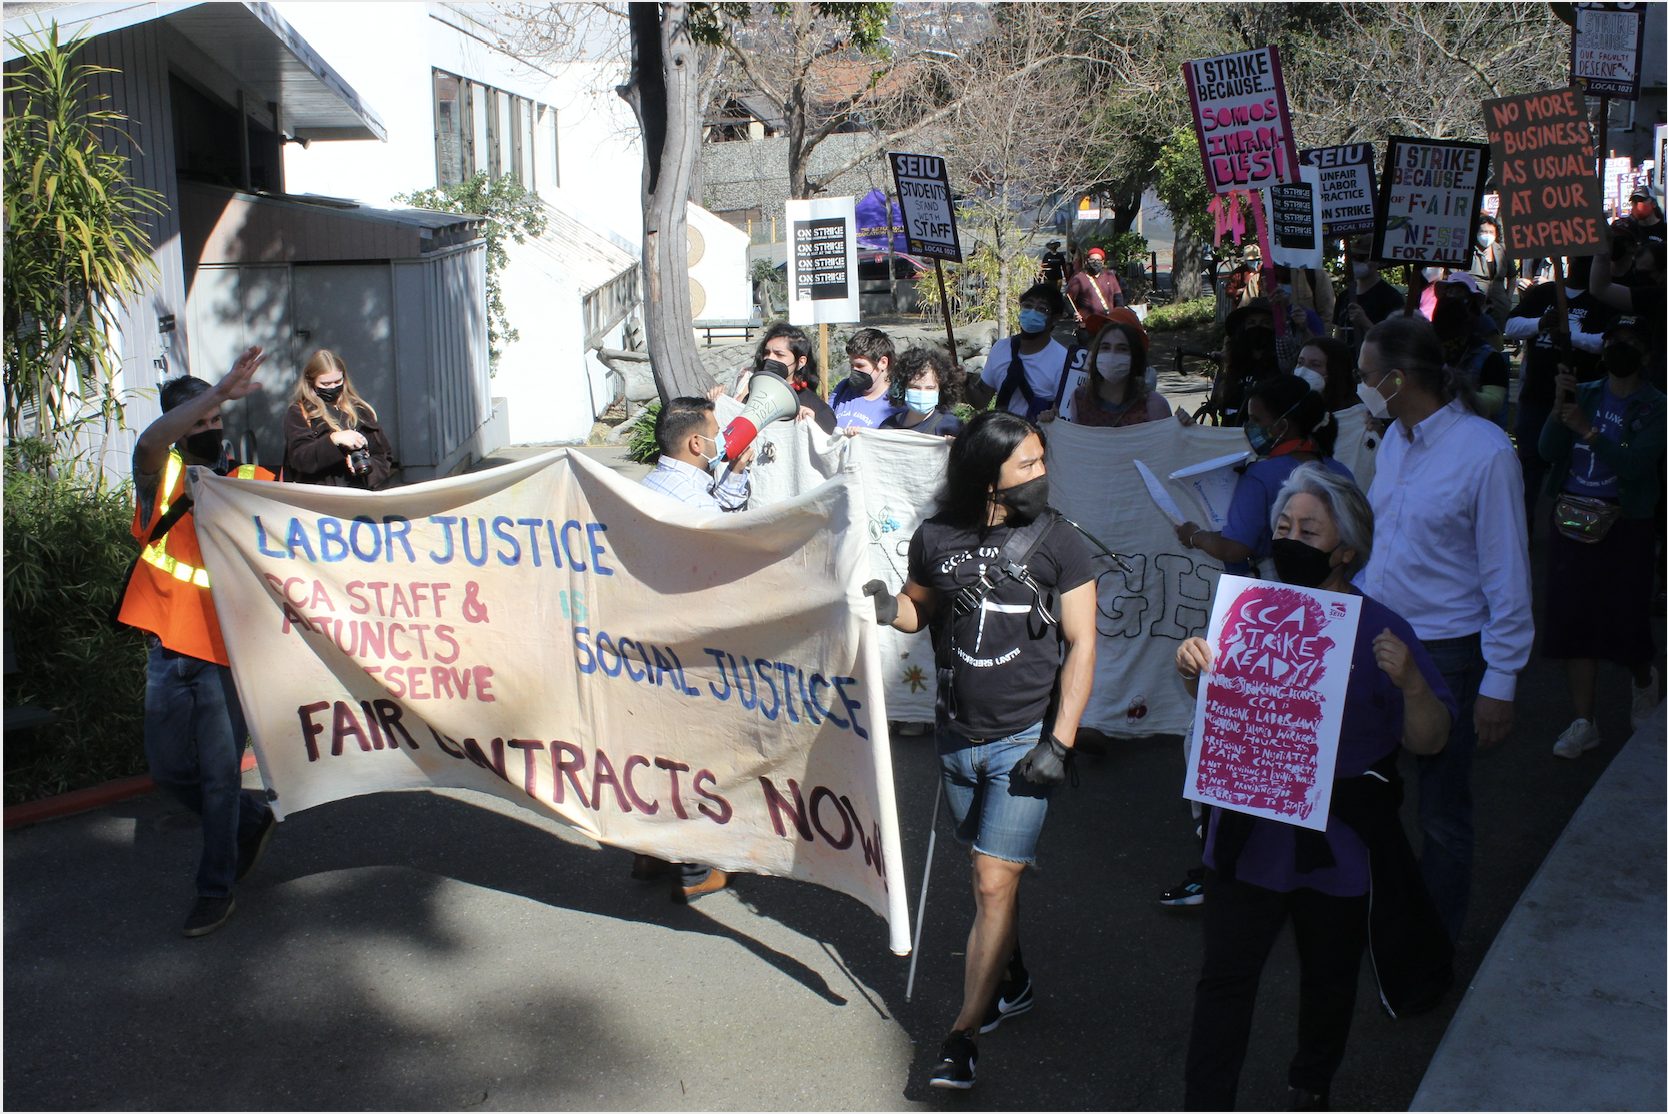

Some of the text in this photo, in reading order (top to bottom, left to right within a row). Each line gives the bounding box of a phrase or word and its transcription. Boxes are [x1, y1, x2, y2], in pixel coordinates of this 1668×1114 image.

[1585, 12, 1636, 35] STRIKE
[1581, 51, 1629, 62] OUR FACULTY
[1194, 52, 1268, 84] I STRIKE
[1580, 61, 1617, 77] DESERVE
[1591, 83, 1616, 91] LOCAL
[1618, 85, 1632, 93] 1021
[1202, 98, 1278, 131] SOMOS
[1492, 92, 1578, 129] NO MORE
[897, 155, 939, 178] SEIU
[1308, 145, 1364, 168] SEIU
[1395, 145, 1475, 172] I STRIKE
[1213, 147, 1284, 187] BLES!
[1320, 169, 1356, 181] UNFAIR
[1502, 159, 1527, 186] AS
[900, 181, 948, 201] STUDENTS
[1323, 180, 1357, 192] LABOR
[915, 200, 939, 211] STAND
[1511, 189, 1533, 217] AT
[1542, 183, 1589, 209] OUR
[1335, 204, 1371, 218] STRIKE
[797, 226, 844, 237] ON STRIKE
[914, 219, 950, 239] STAFF
[1332, 223, 1357, 232] LOCAL
[1405, 225, 1465, 247] NESS
[1511, 217, 1600, 249] EXPENSE
[797, 242, 844, 252] ON STRIKE
[924, 245, 943, 254] LOCAL
[1392, 246, 1428, 260] FOR
[798, 257, 845, 268] ON STRIKE
[799, 272, 845, 282] ON STRIKE
[252, 514, 614, 576] LABOR JUSTICE
[345, 580, 451, 619] STAFF
[462, 581, 490, 624] &
[559, 588, 587, 623] IS
[1240, 598, 1306, 631] CCA
[1221, 641, 1319, 686] READY!
[574, 627, 869, 741] SOCIAL JUSTICE
[1249, 697, 1276, 710] CCA
[1256, 710, 1293, 727] LABOR
[298, 699, 419, 762] FAIR
[1207, 760, 1222, 769] NOT
[1208, 777, 1227, 786] NOT
[1264, 797, 1276, 806] TO
